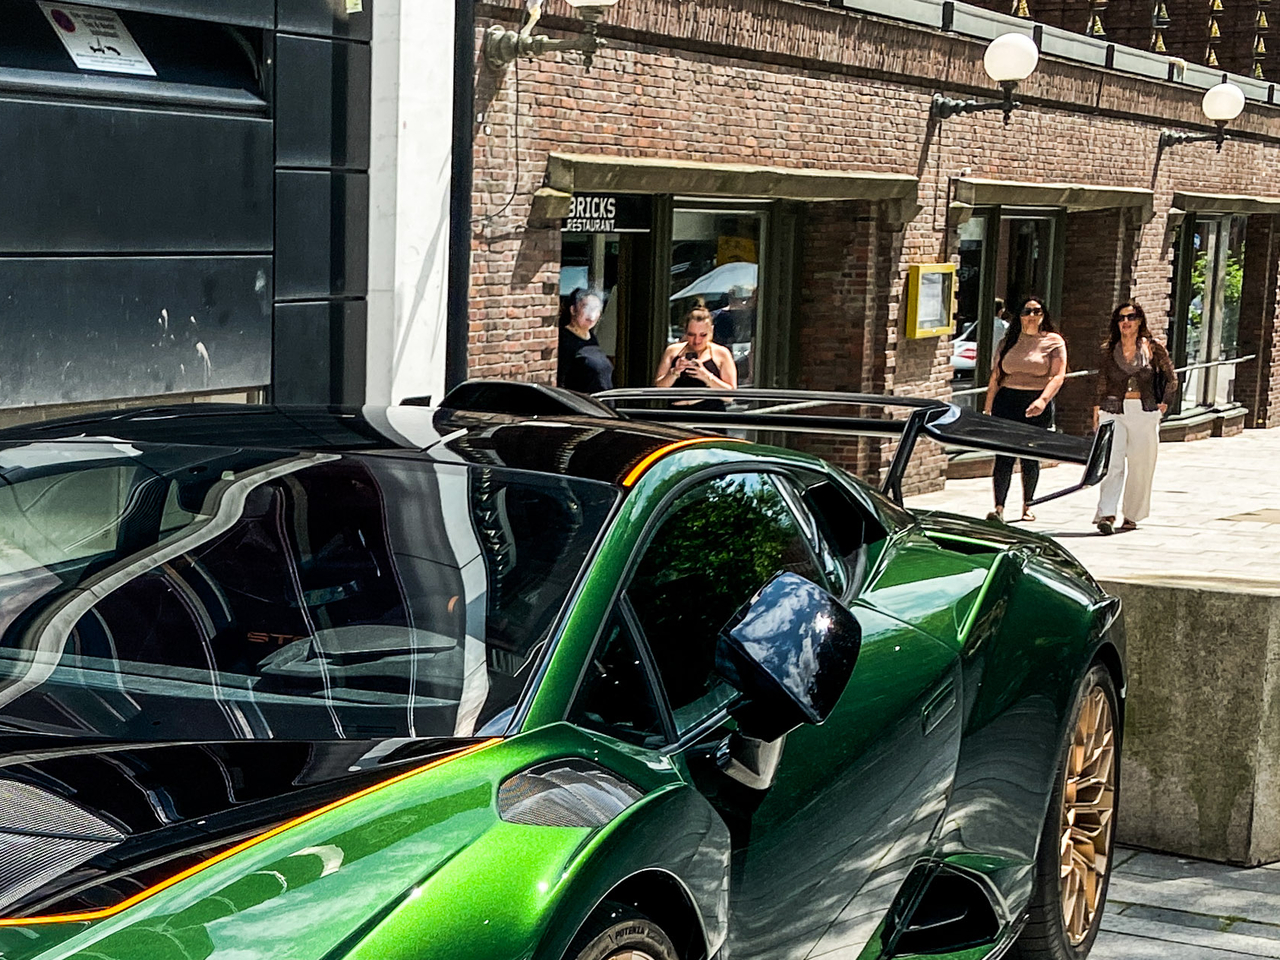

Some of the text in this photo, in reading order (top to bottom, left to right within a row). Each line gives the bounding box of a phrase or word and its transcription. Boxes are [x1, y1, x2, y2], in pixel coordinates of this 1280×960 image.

[568, 196, 616, 218] BRICKS
[566, 219, 615, 232] RESTAURANT
[615, 926, 645, 939] POTENZA
